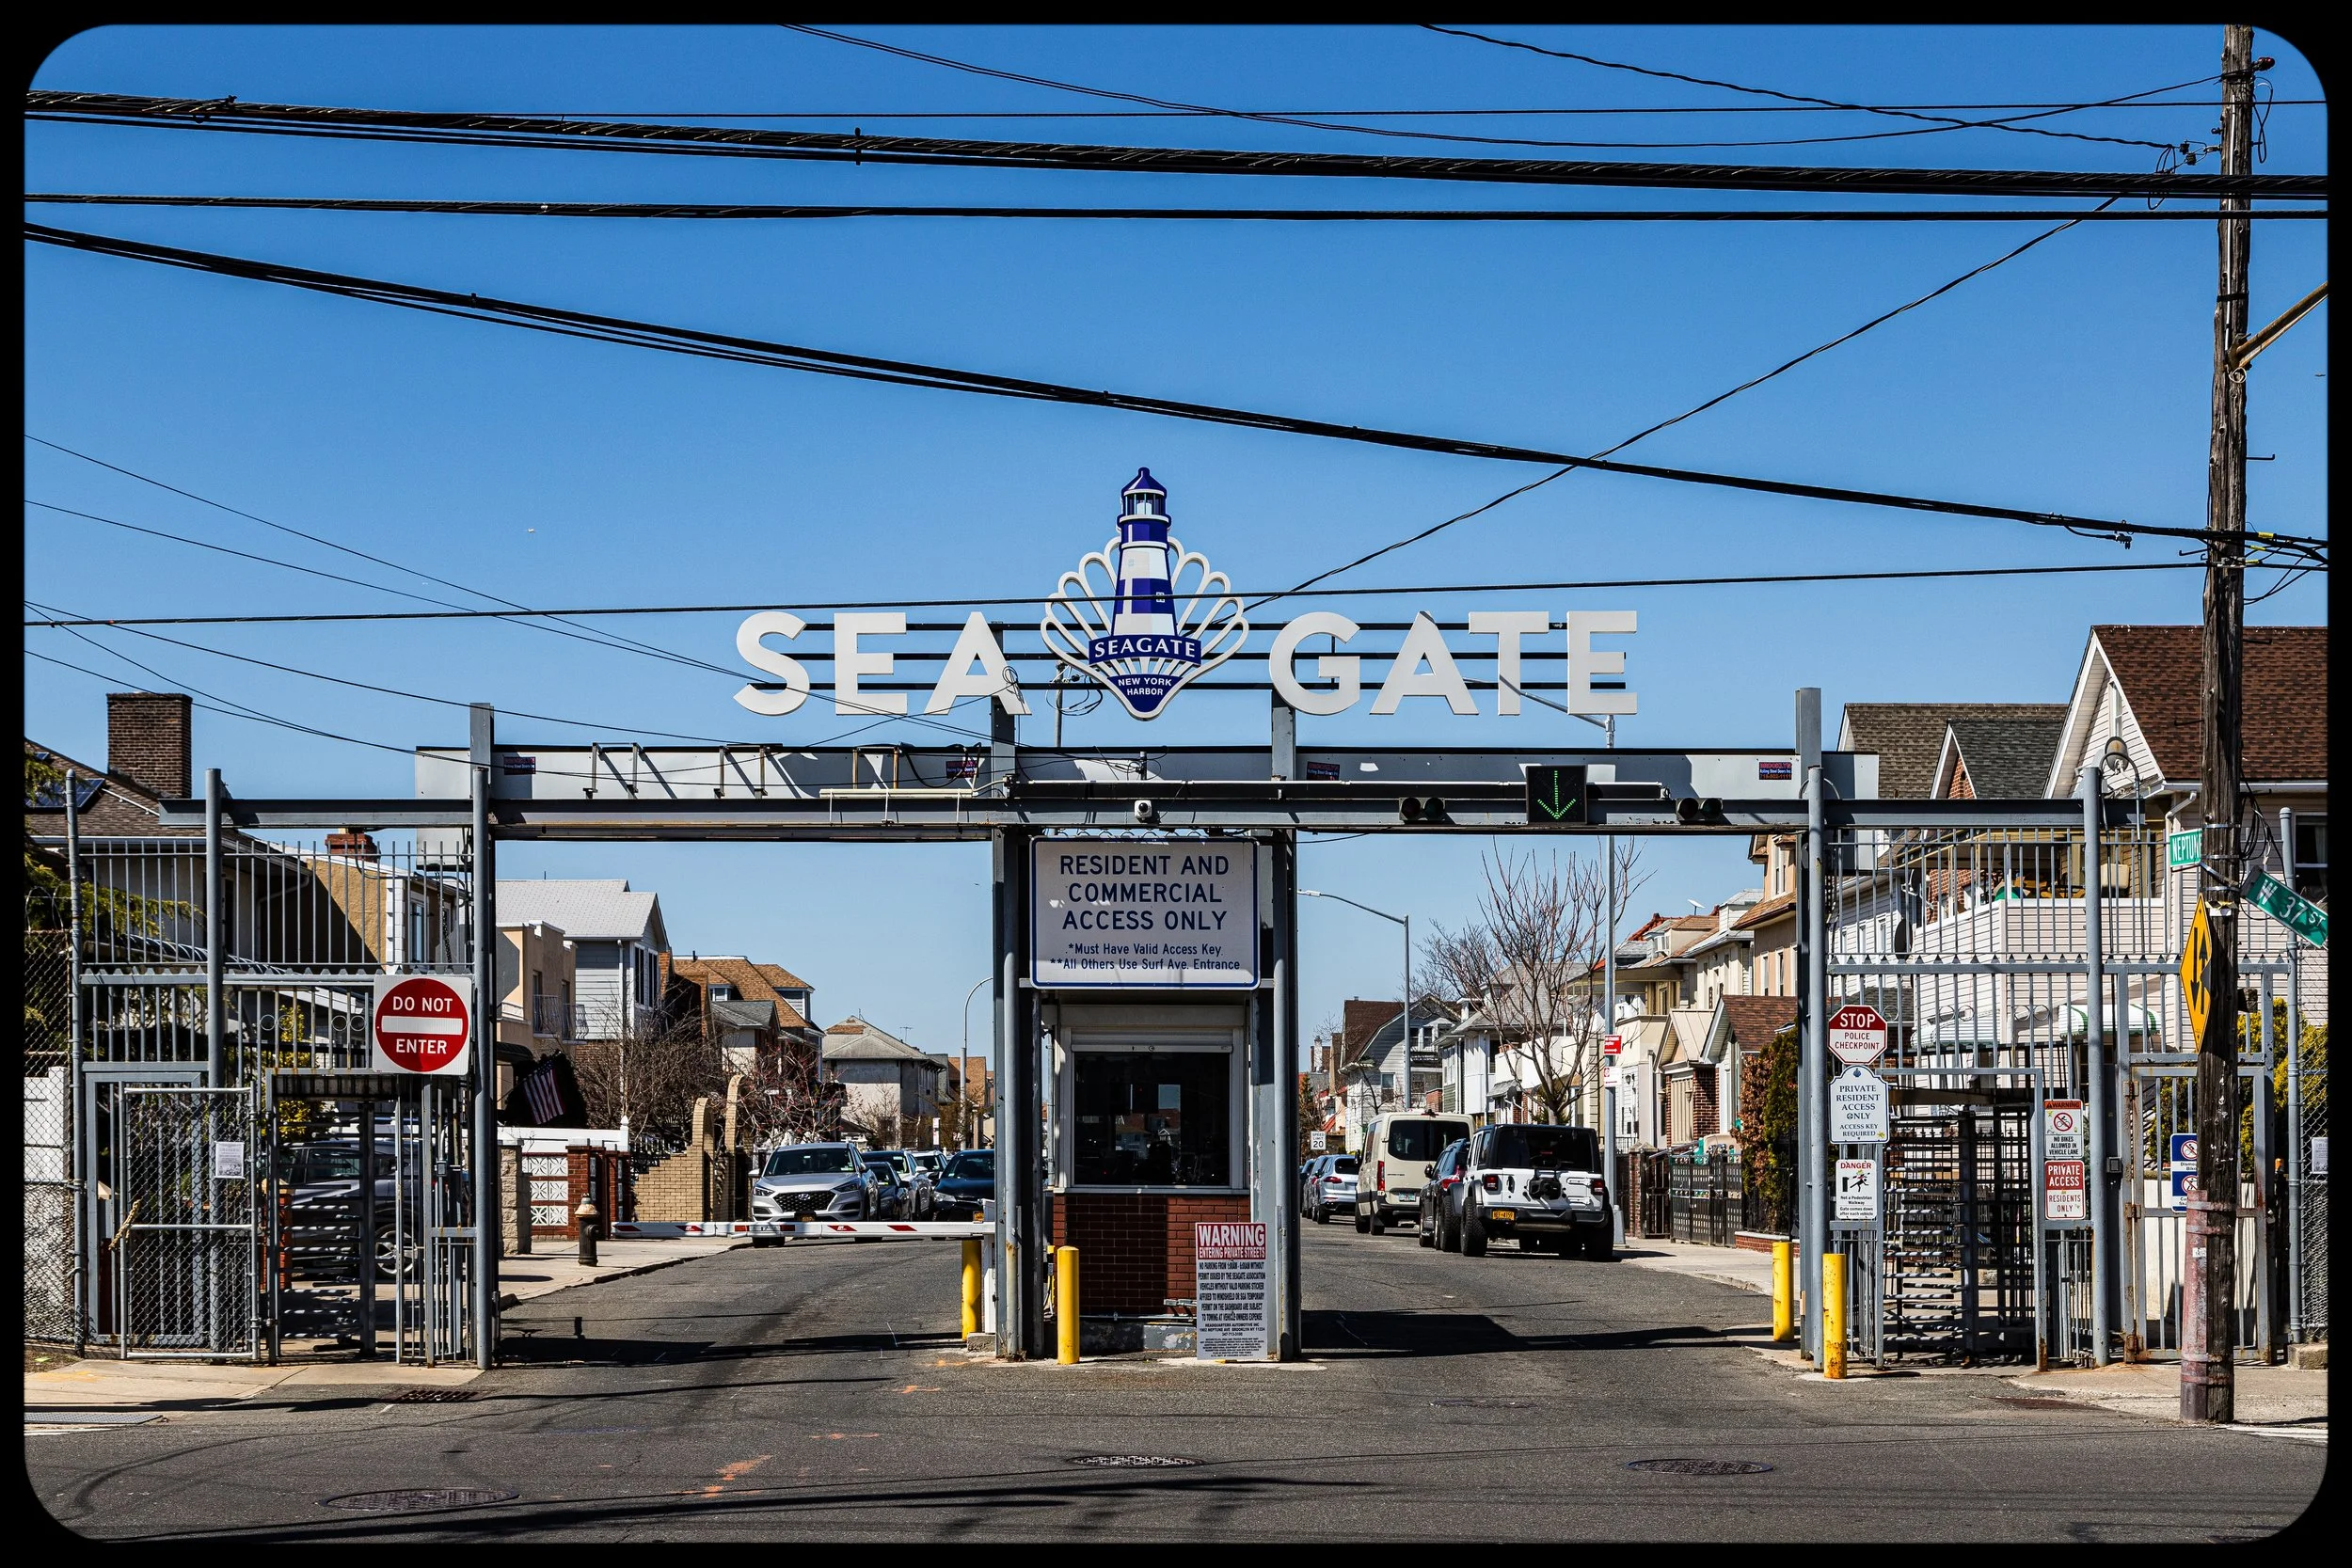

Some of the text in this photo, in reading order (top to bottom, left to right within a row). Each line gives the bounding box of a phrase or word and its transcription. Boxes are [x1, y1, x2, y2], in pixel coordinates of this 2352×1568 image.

[1094, 637, 1196, 657] SEAGATE
[733, 610, 1637, 716] SEA GATE
[1118, 677, 1172, 687] NEW YORK
[1127, 688, 1164, 696] HARBOR
[1060, 855, 1229, 876] RESIDENT AND
[1068, 883, 1222, 903] COMMERCIAL
[2256, 879, 2326, 927] W 37 ST
[1062, 910, 1227, 930] ACCESS ONLY
[1103, 943, 1129, 955] Have
[1133, 943, 1158, 955] Valid
[1162, 943, 1197, 955] Access
[1082, 958, 1114, 970] Others
[1119, 958, 1137, 970] Use
[1142, 958, 1164, 970] Surf
[1167, 958, 1189, 970] Ave.
[1193, 958, 1240, 970] Entrance
[393, 996, 453, 1012] DO NOT
[1840, 1013, 1876, 1028] STOP
[396, 1038, 447, 1054] ENTER
[1835, 1042, 1880, 1050] CHECKPOINT
[2048, 1165, 2081, 1176] PRIVATE
[2049, 1177, 2080, 1187] ACCESS
[1198, 1225, 1264, 1247] WARNING
[1199, 1247, 1265, 1258] ENTERING PRIVATE STREETS
